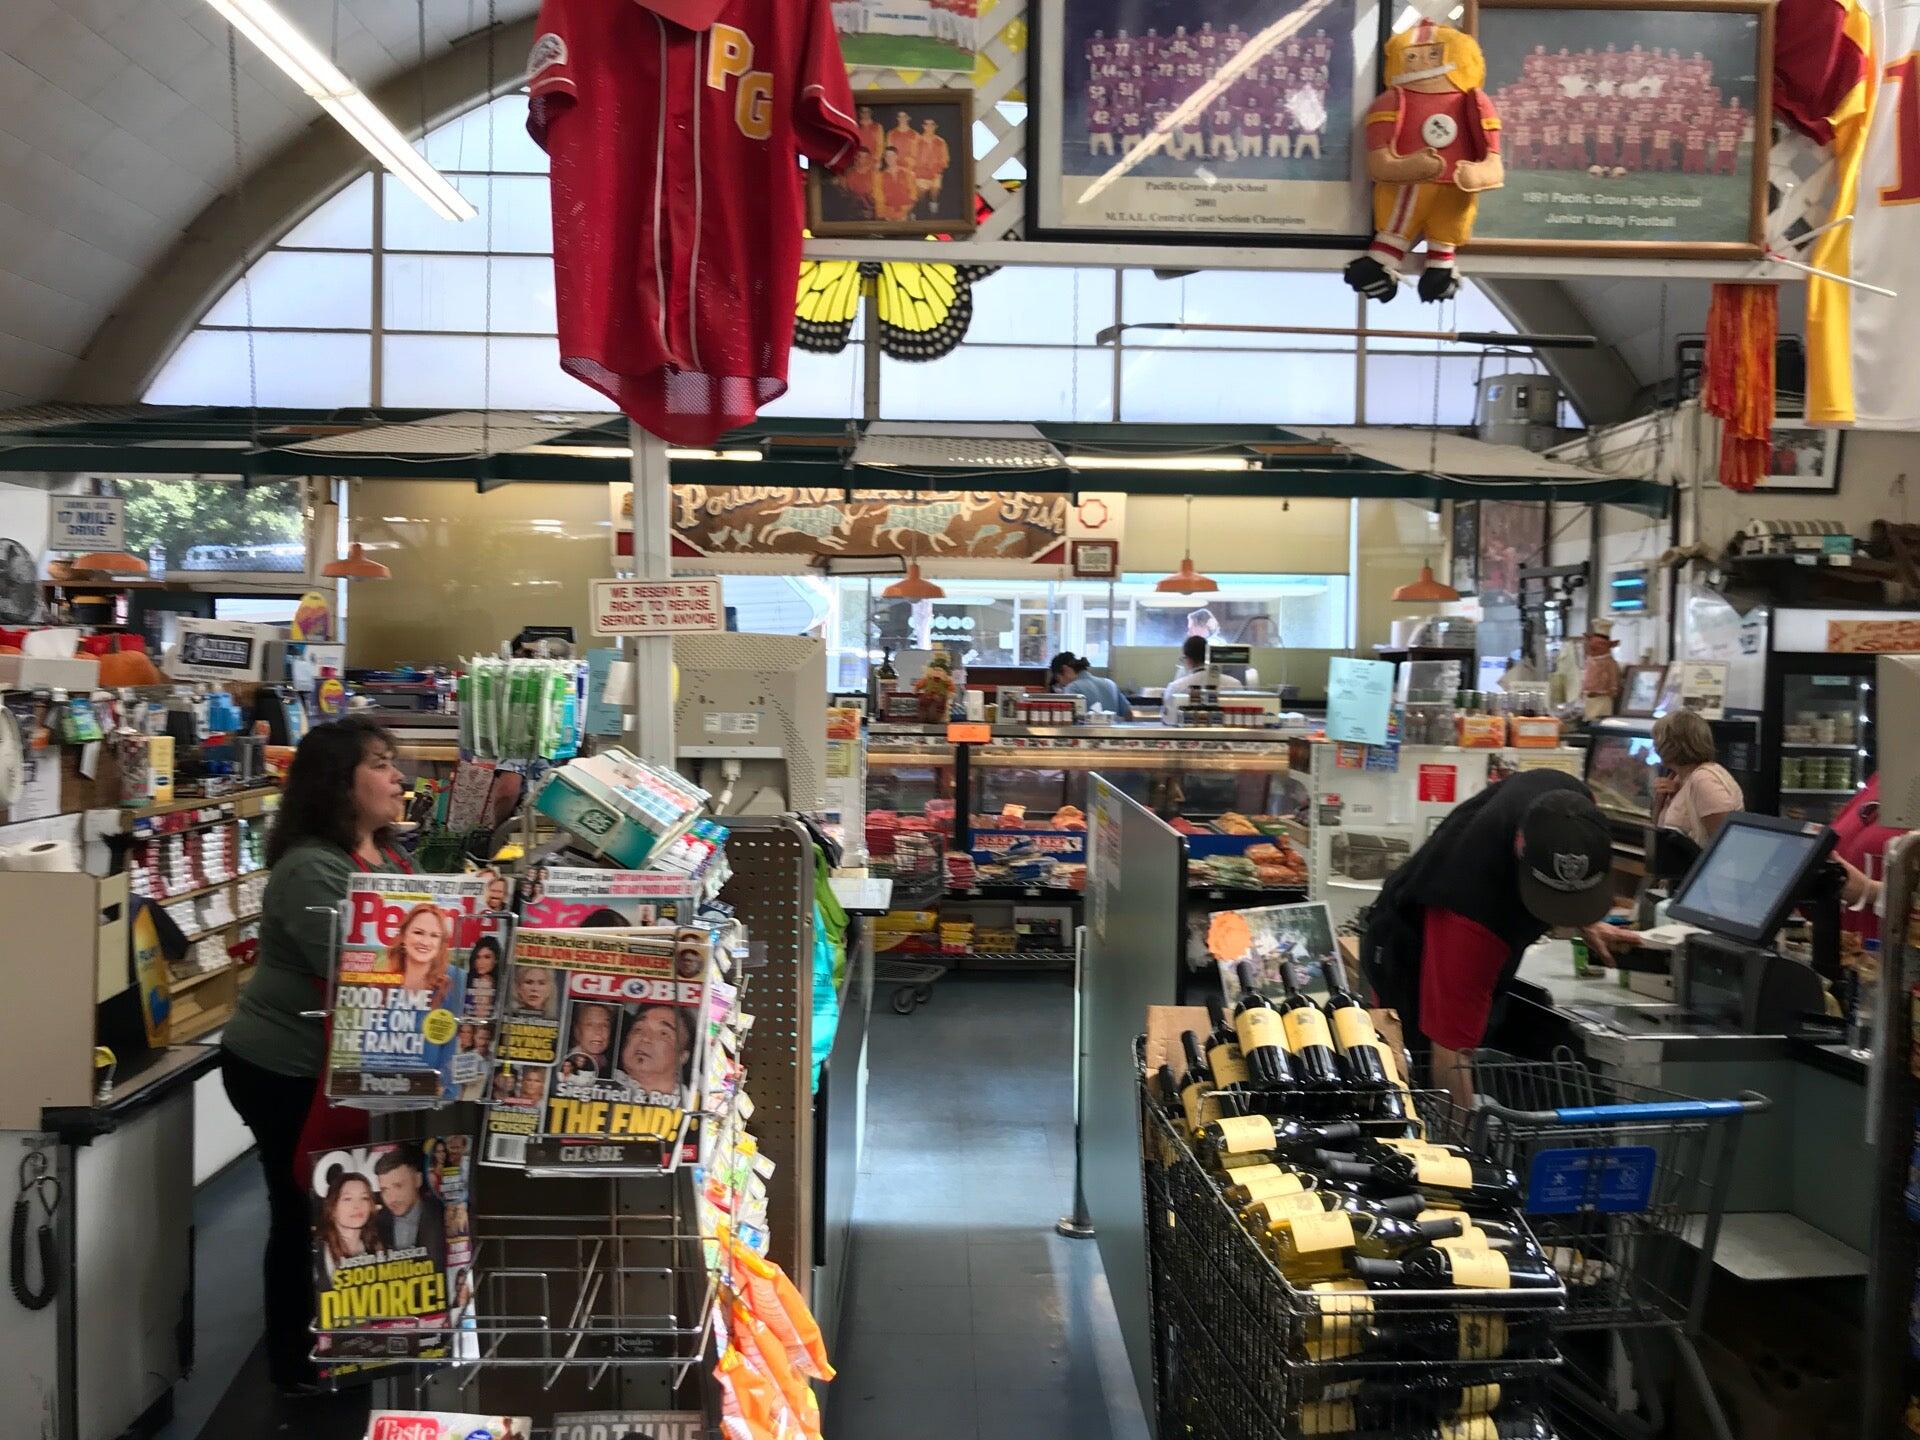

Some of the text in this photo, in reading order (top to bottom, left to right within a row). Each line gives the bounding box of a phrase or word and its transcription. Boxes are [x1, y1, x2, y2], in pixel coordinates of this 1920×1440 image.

[1145, 181, 1177, 192] Pacific
[1179, 182, 1207, 192] Grove
[1237, 183, 1268, 192] School
[1551, 192, 1592, 204] Pacific
[1593, 194, 1629, 205] Grove
[1629, 195, 1659, 208] High
[1660, 195, 1702, 207] School
[1150, 213, 1185, 222] Central
[1217, 214, 1250, 224] Section
[1252, 215, 1306, 225] Champions
[1545, 213, 1677, 228] Junior Varsity Football
[610, 585, 710, 598] WE RESERVE THE
[609, 600, 711, 611] RIGHT TO REFUSE
[601, 612, 717, 626] SERVICE TO ANYONE
[387, 988, 434, 1011] FAME
[571, 973, 702, 1004] GLOBE
[389, 1010, 416, 1032] ON
[333, 1030, 426, 1055] THE RANCH
[360, 1073, 411, 1095] People
[555, 1082, 681, 1107] Siegfried & Roy
[551, 1097, 684, 1143] THE END!
[560, 1145, 625, 1162] GLOBE
[333, 1260, 434, 1291] $300 Million
[321, 1272, 447, 1330] DIVORCE!
